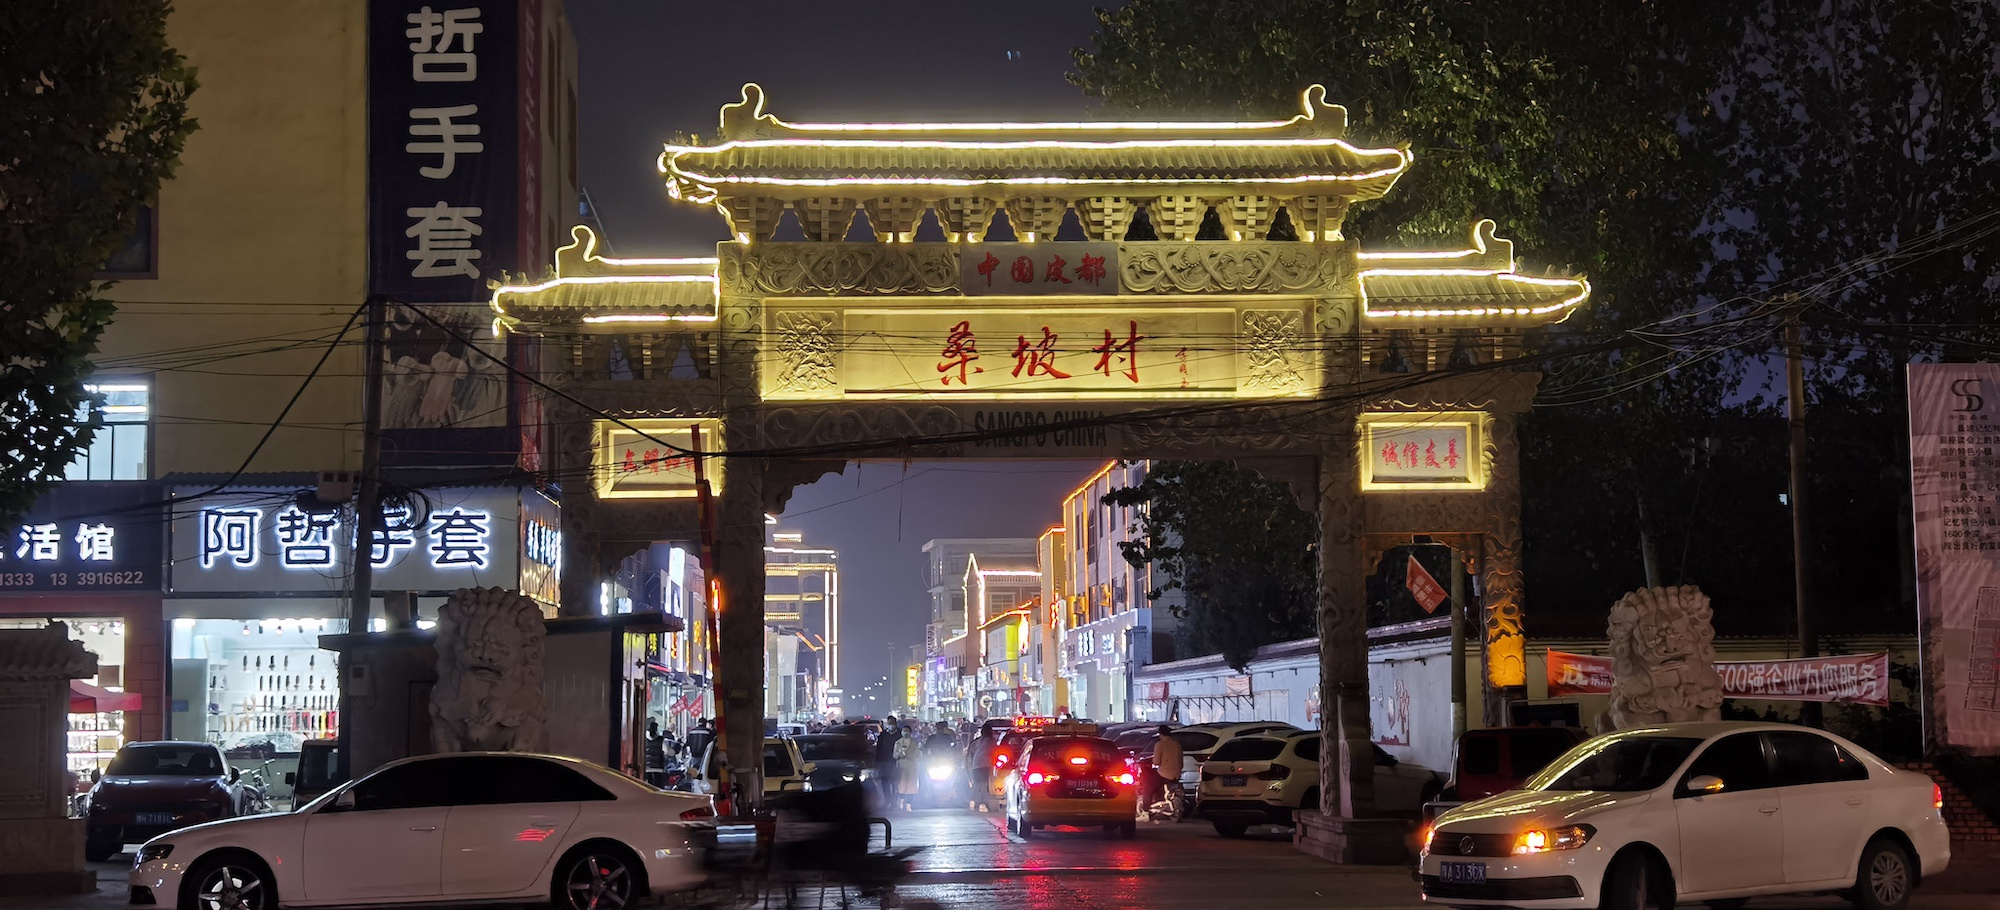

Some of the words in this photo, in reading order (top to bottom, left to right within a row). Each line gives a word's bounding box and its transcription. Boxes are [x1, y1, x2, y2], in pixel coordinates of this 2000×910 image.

[405, 6, 484, 280] 哲手套
[977, 251, 1106, 287] 中国皮都
[974, 410, 1047, 447] SANGPO
[1053, 410, 1107, 447] CHINA
[0, 523, 114, 561] 活馆
[200, 506, 491, 568] 阿哲手套
[77, 571, 144, 586] 3916622
